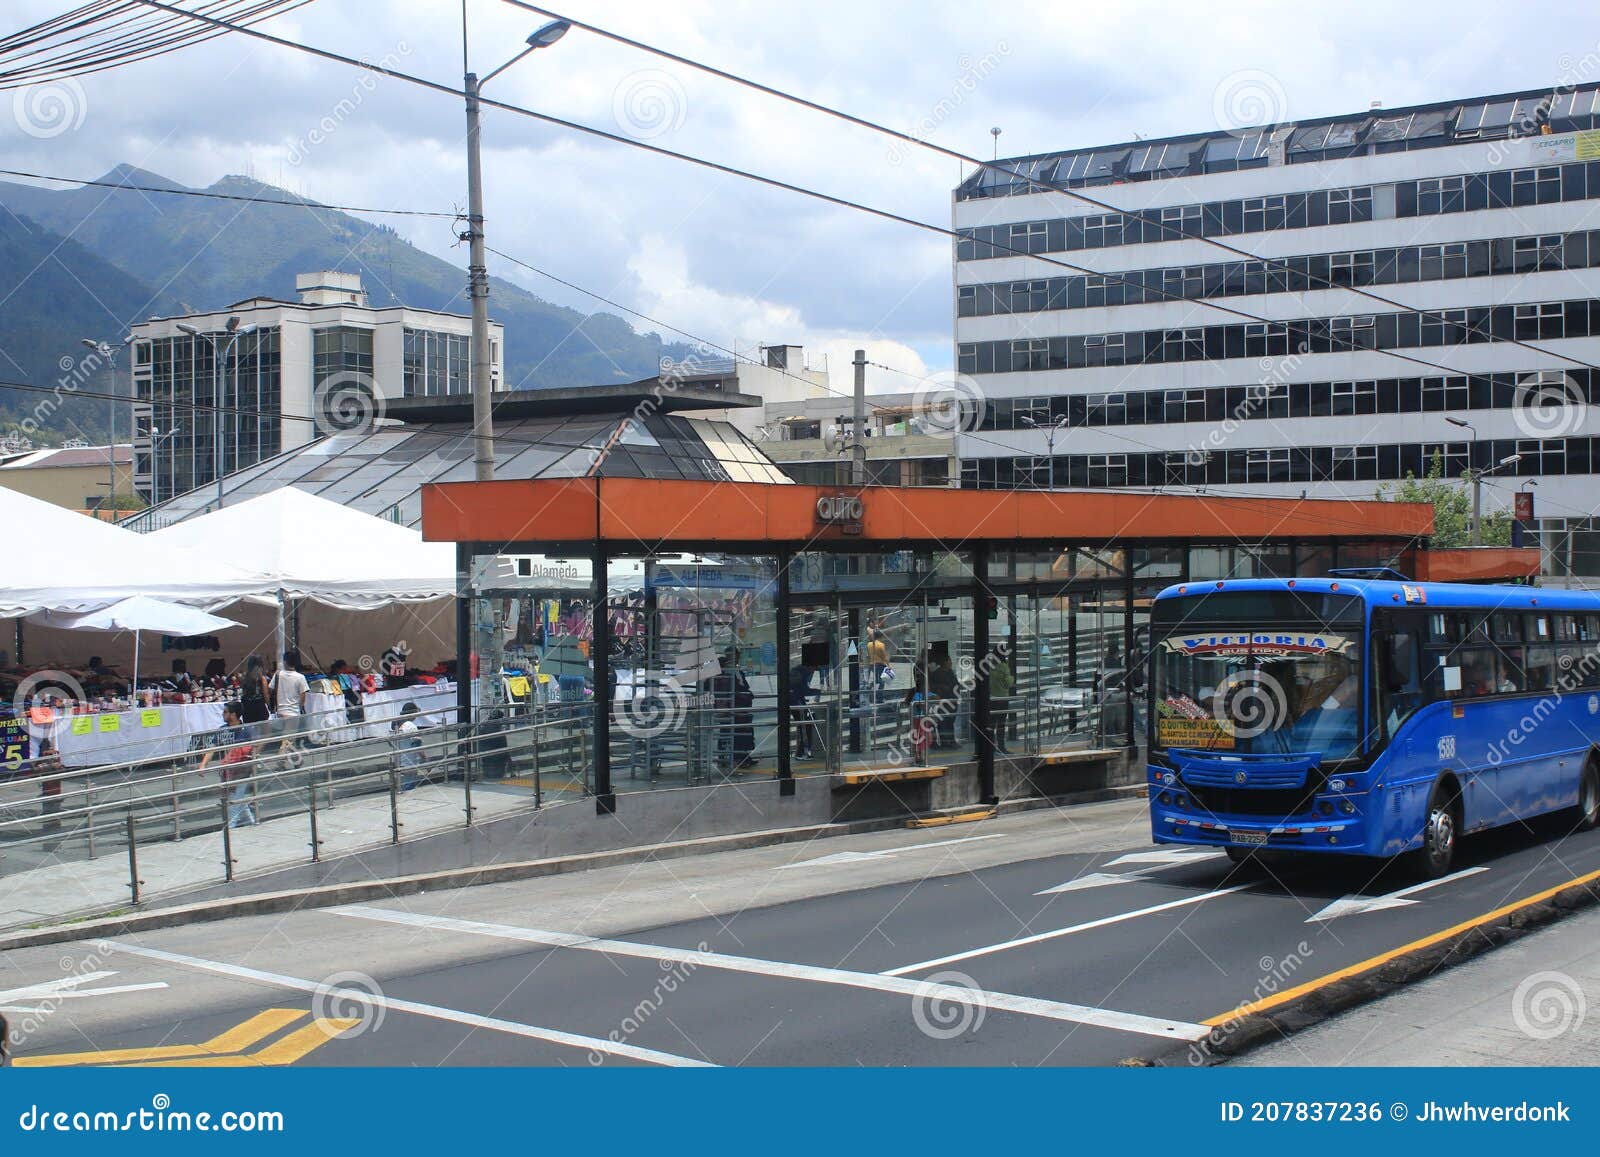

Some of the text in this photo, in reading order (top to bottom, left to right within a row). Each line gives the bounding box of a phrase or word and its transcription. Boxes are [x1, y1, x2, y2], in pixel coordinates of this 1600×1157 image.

[532, 564, 578, 578] Alameda
[1182, 634, 1327, 648] VICTORIA
[5, 745, 23, 770] 5
